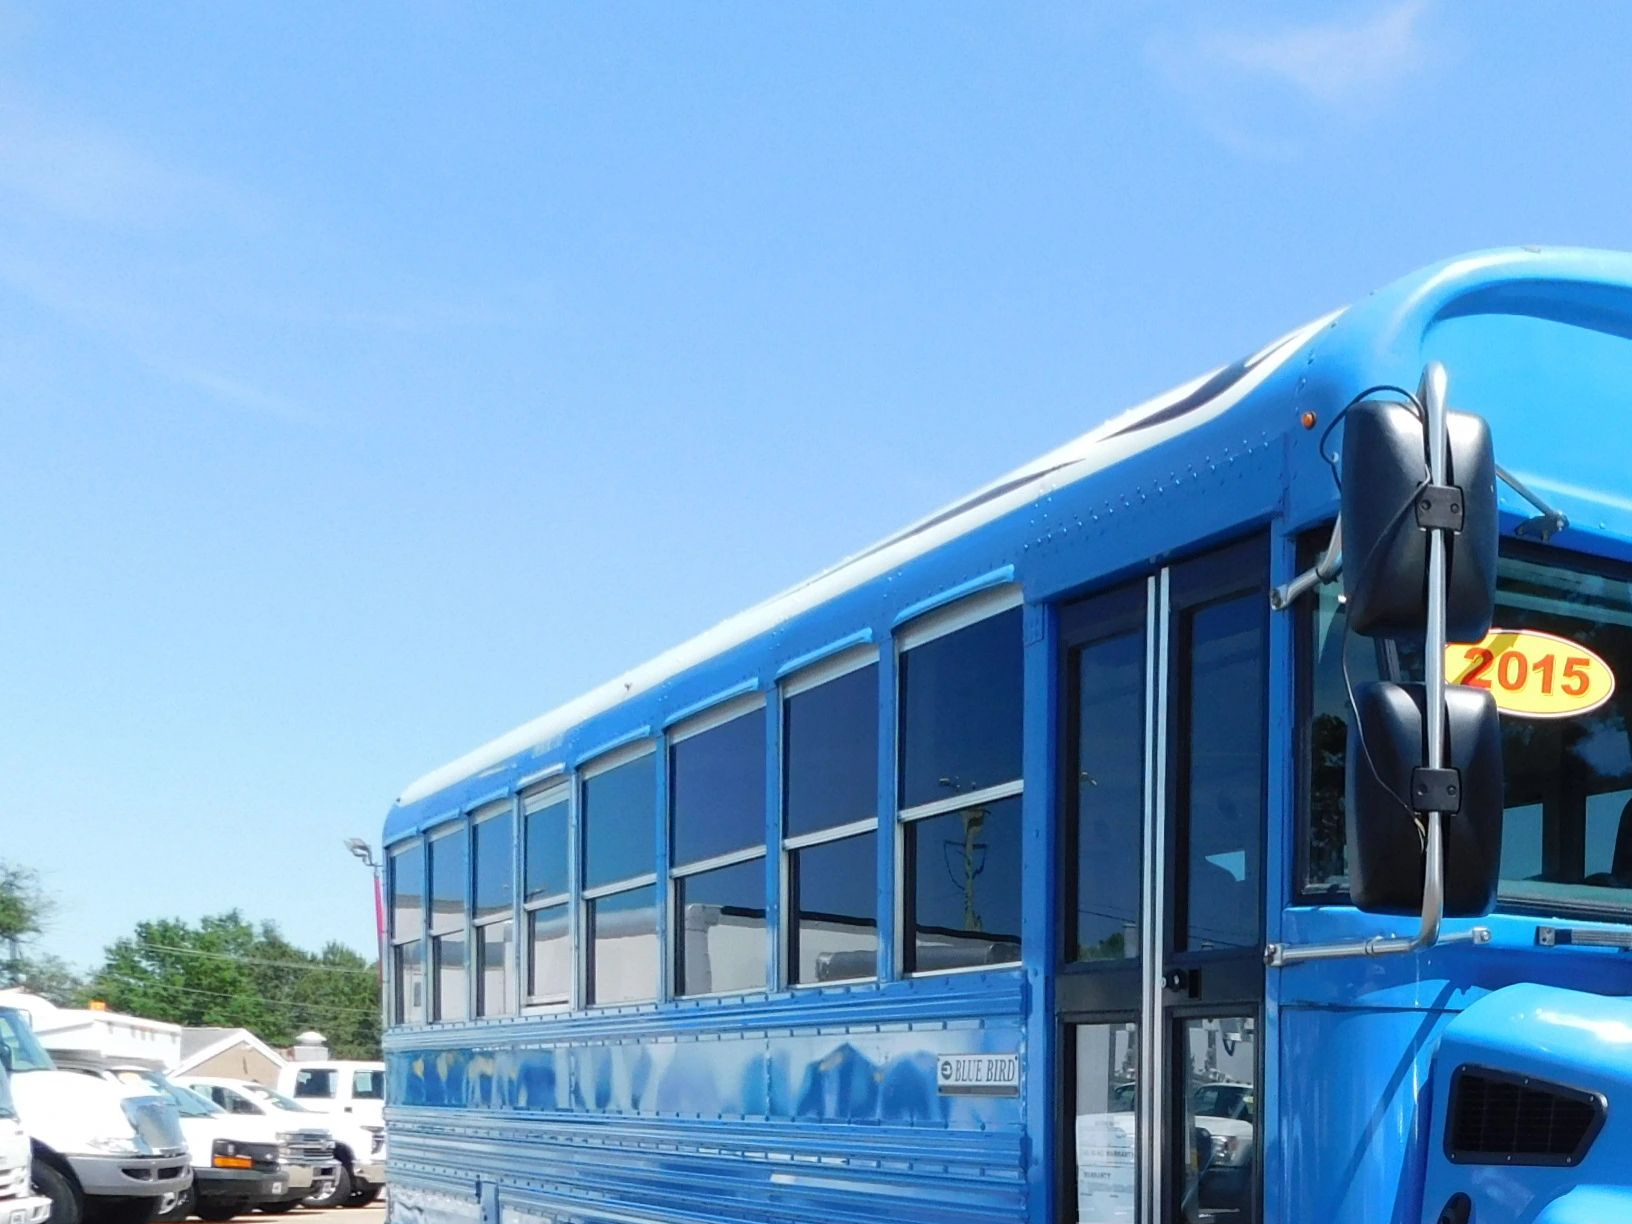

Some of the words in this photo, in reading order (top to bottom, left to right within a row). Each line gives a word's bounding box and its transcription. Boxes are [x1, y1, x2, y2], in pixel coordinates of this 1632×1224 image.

[1461, 647, 1591, 696] 2015
[954, 1059, 983, 1082] BLUE
[986, 1059, 1015, 1082] BIRD
